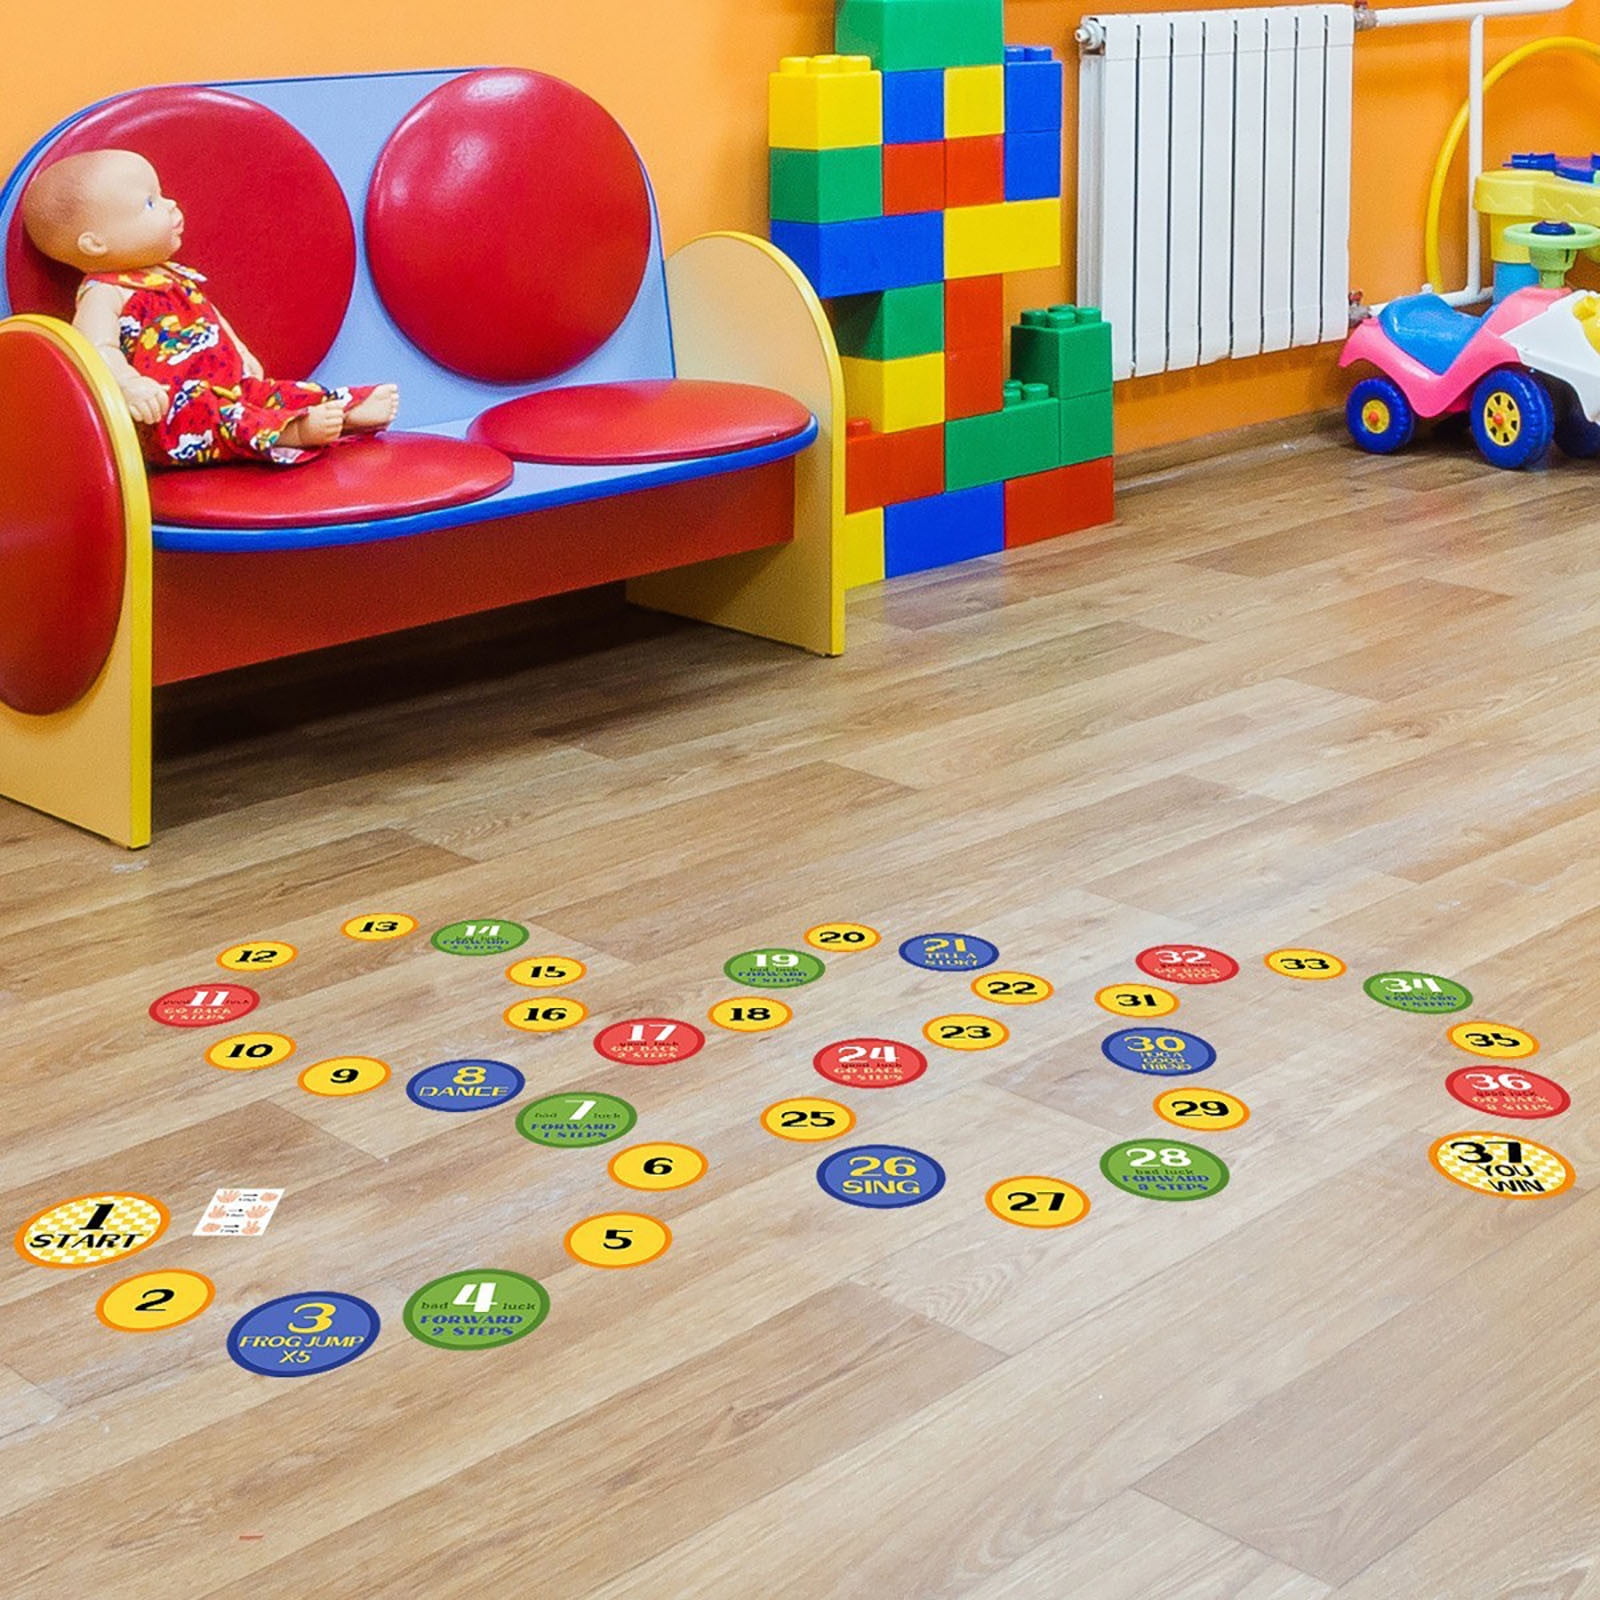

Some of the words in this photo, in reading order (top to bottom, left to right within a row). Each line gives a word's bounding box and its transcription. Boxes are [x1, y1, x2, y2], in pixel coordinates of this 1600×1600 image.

[360, 921, 399, 932] 13
[465, 925, 500, 936] 14
[819, 931, 865, 943] 20
[923, 938, 966, 952] 21
[235, 950, 278, 963] 12
[754, 954, 799, 967] 19
[1155, 950, 1210, 963] 32
[1280, 958, 1330, 970] 33
[530, 966, 567, 978] 15
[987, 981, 1038, 995] 22
[1380, 978, 1443, 992] 34
[186, 991, 230, 1006] 11
[1116, 994, 1157, 1006] 31
[524, 1007, 568, 1021] 16
[730, 1007, 772, 1021] 18
[627, 1024, 677, 1041] 17
[940, 1025, 992, 1039] 23
[1124, 1036, 1186, 1052] 30
[1465, 1033, 1520, 1047] 35
[226, 1044, 273, 1057] 10
[838, 1046, 900, 1063] 24
[330, 1069, 359, 1083] 9
[453, 1066, 486, 1085] 8
[1465, 1073, 1532, 1091] 36
[419, 1087, 509, 1097] DANCE
[565, 1100, 596, 1120] 7
[1171, 1100, 1229, 1117] 29
[781, 1111, 836, 1127] 25
[1126, 1148, 1192, 1167] 28
[1450, 1141, 1522, 1163] 37
[643, 1157, 673, 1175] 6
[850, 1156, 917, 1177] 26
[1477, 1164, 1534, 1177] YOU
[842, 1180, 920, 1194] SING
[1488, 1179, 1545, 1192] WIN
[1008, 1192, 1065, 1211] 27
[79, 1203, 114, 1230] 1
[30, 1234, 143, 1248] START
[603, 1229, 633, 1249] 5
[135, 1289, 174, 1311] 2
[452, 1282, 498, 1312] 4
[288, 1303, 336, 1333] 3
[420, 1315, 523, 1324] FORWARD
[453, 1327, 513, 1335] STEPS
[239, 1336, 301, 1347] FROG
[308, 1336, 364, 1347] JUMP
[280, 1350, 310, 1363] X5
